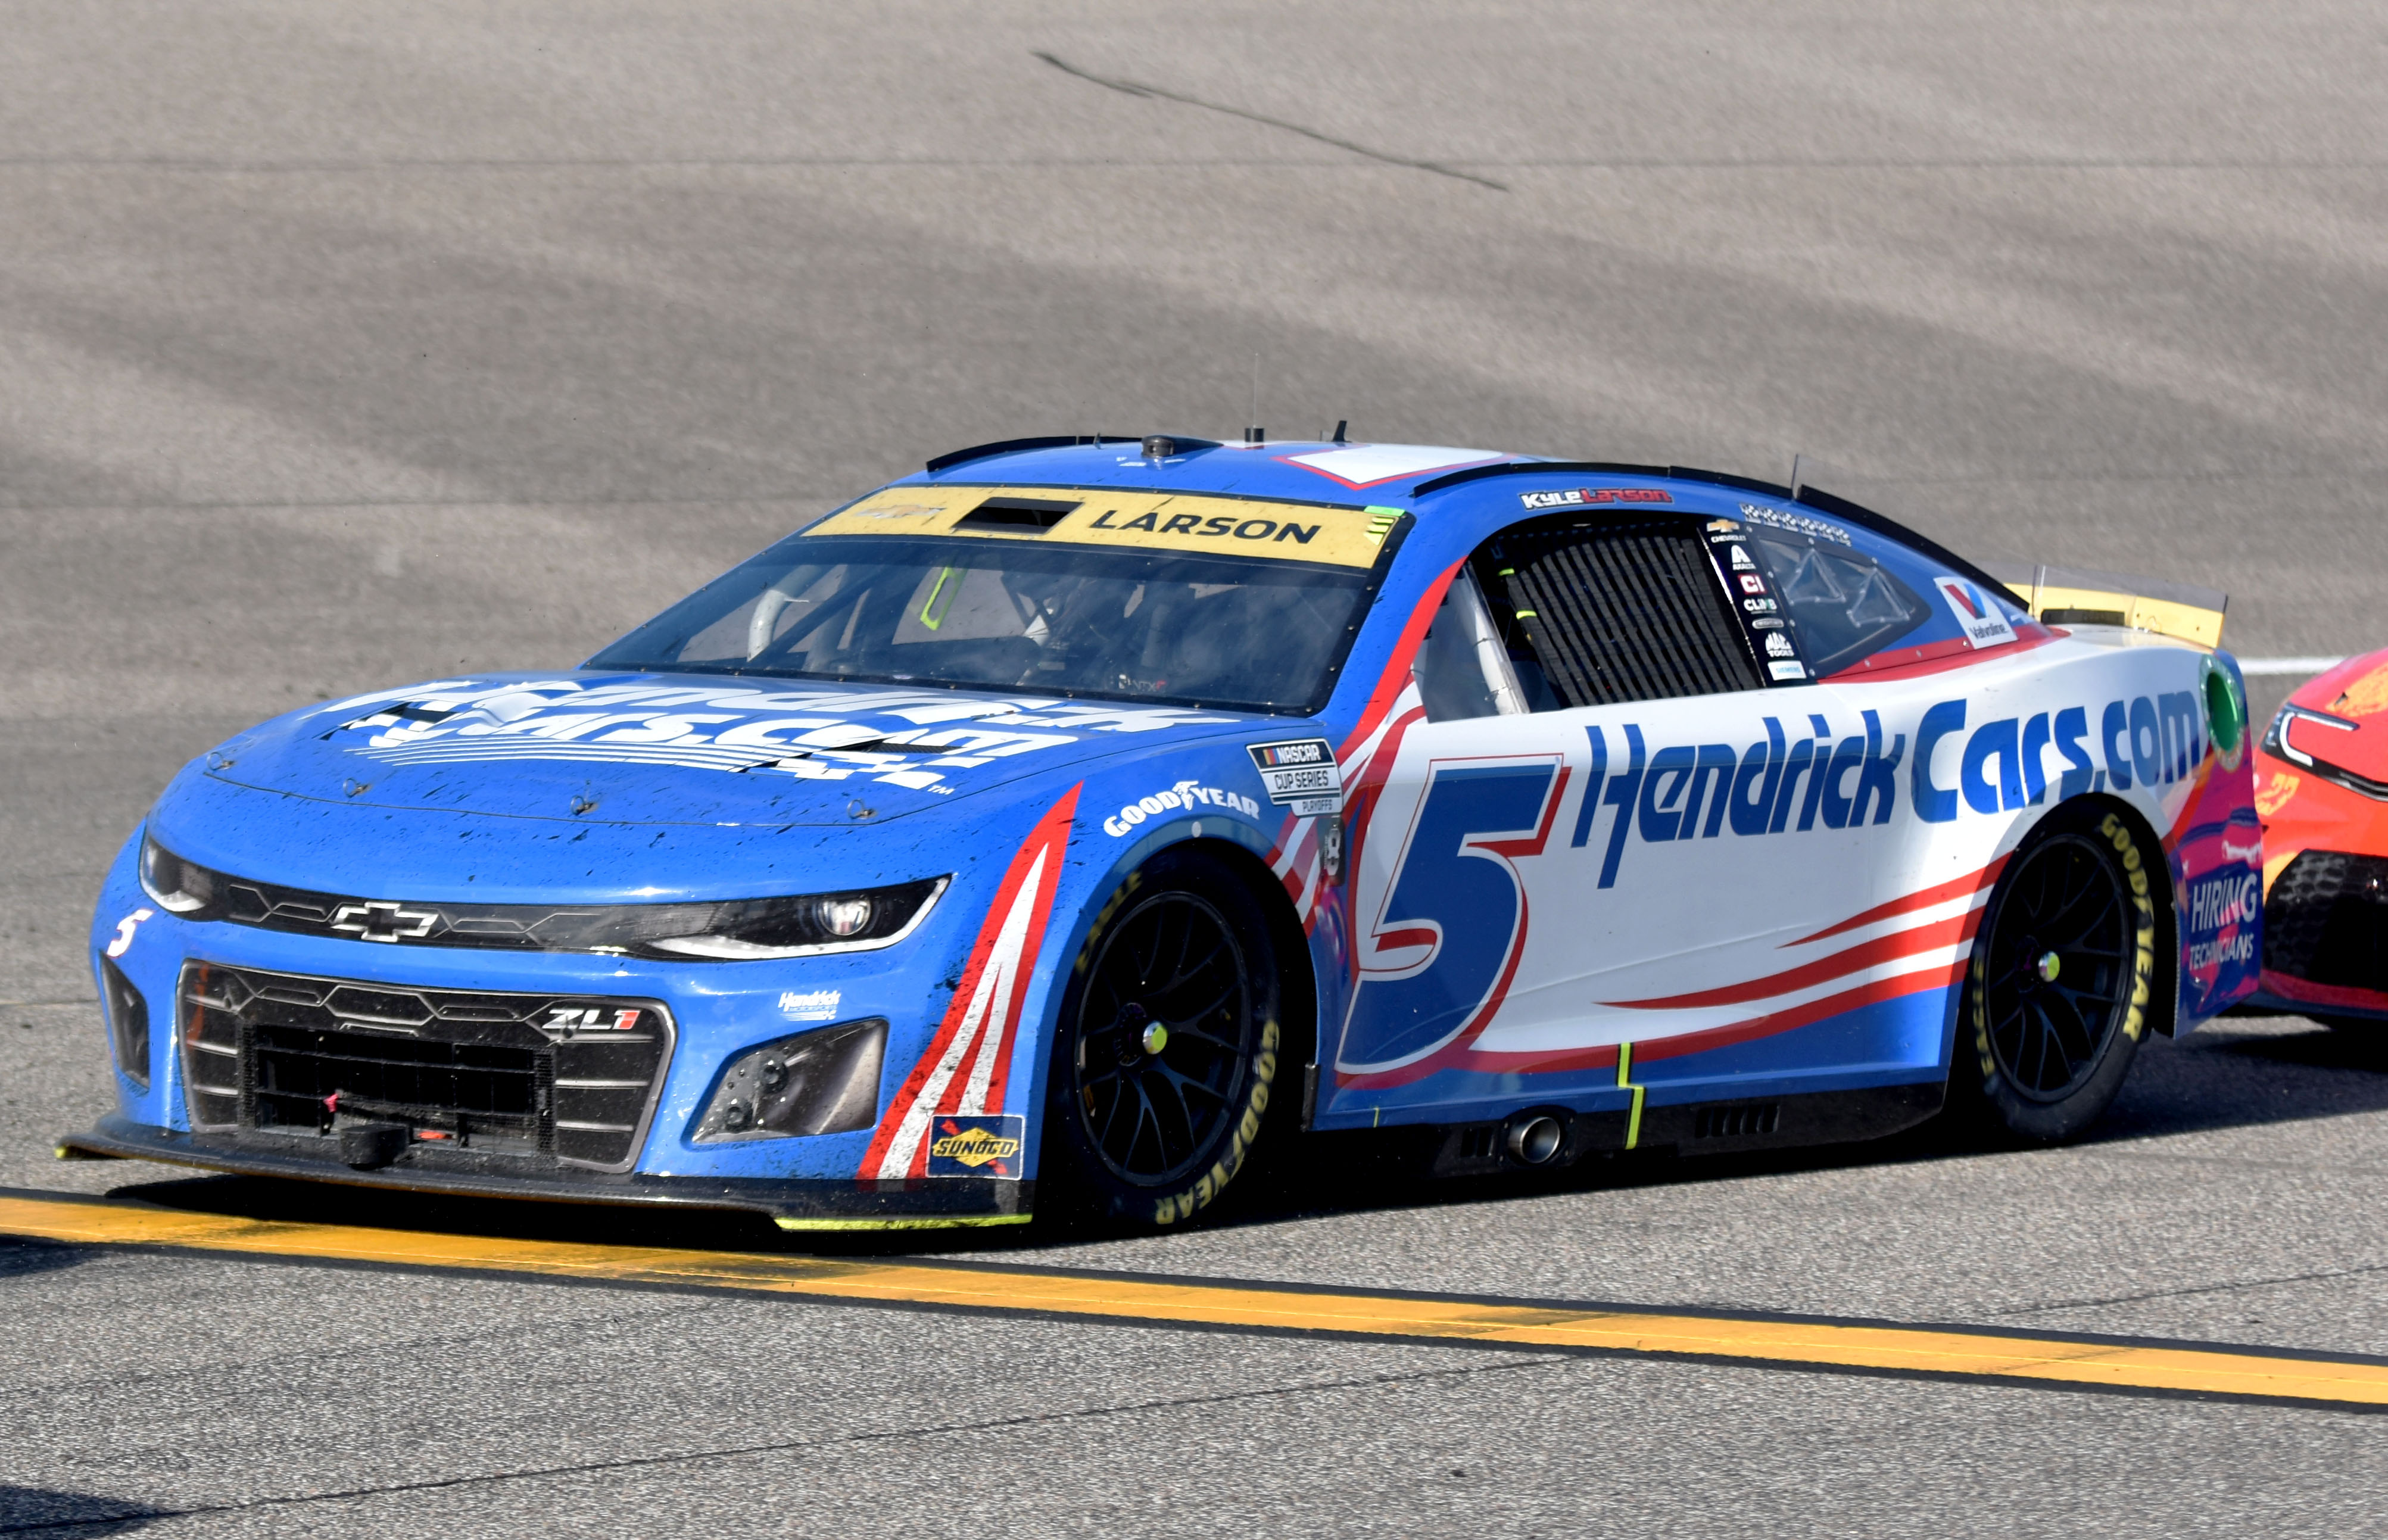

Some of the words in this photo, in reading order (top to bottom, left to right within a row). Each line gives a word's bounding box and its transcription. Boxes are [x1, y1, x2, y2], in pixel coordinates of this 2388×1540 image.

[1089, 510, 1322, 544] LARSON
[1276, 744, 1322, 764] NASCAR
[927, 785, 955, 795] TM
[1274, 773, 1293, 790] CUP
[1295, 770, 1329, 788] SERIES
[1338, 753, 1571, 1073] 5
[2191, 872, 2258, 933] HIRING
[106, 908, 156, 959] 5
[2189, 933, 2254, 971] TECHNICIANS
[778, 990, 841, 1012] Hendrick
[541, 1009, 641, 1030] ZL1
[936, 1139, 1016, 1155] SUNOCO
